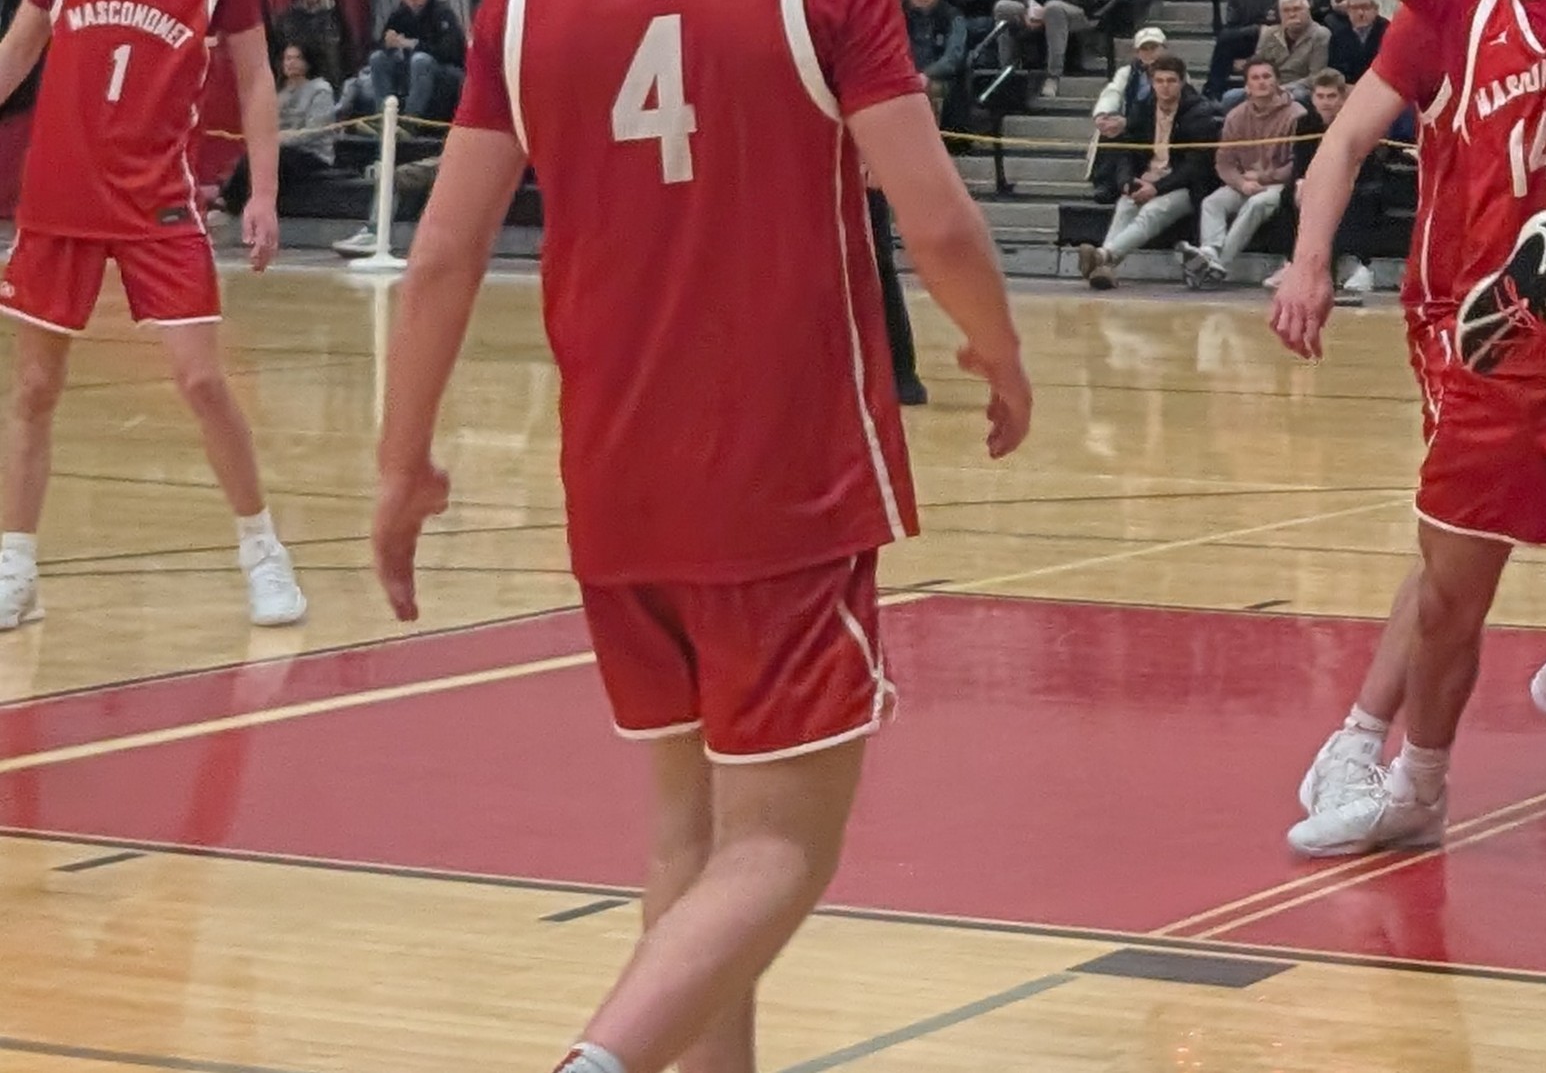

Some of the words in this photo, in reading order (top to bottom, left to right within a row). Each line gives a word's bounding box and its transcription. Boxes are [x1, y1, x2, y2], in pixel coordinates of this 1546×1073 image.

[66, 0, 194, 49] MASCONOMET
[107, 44, 132, 102] 1
[612, 13, 697, 184] 4
